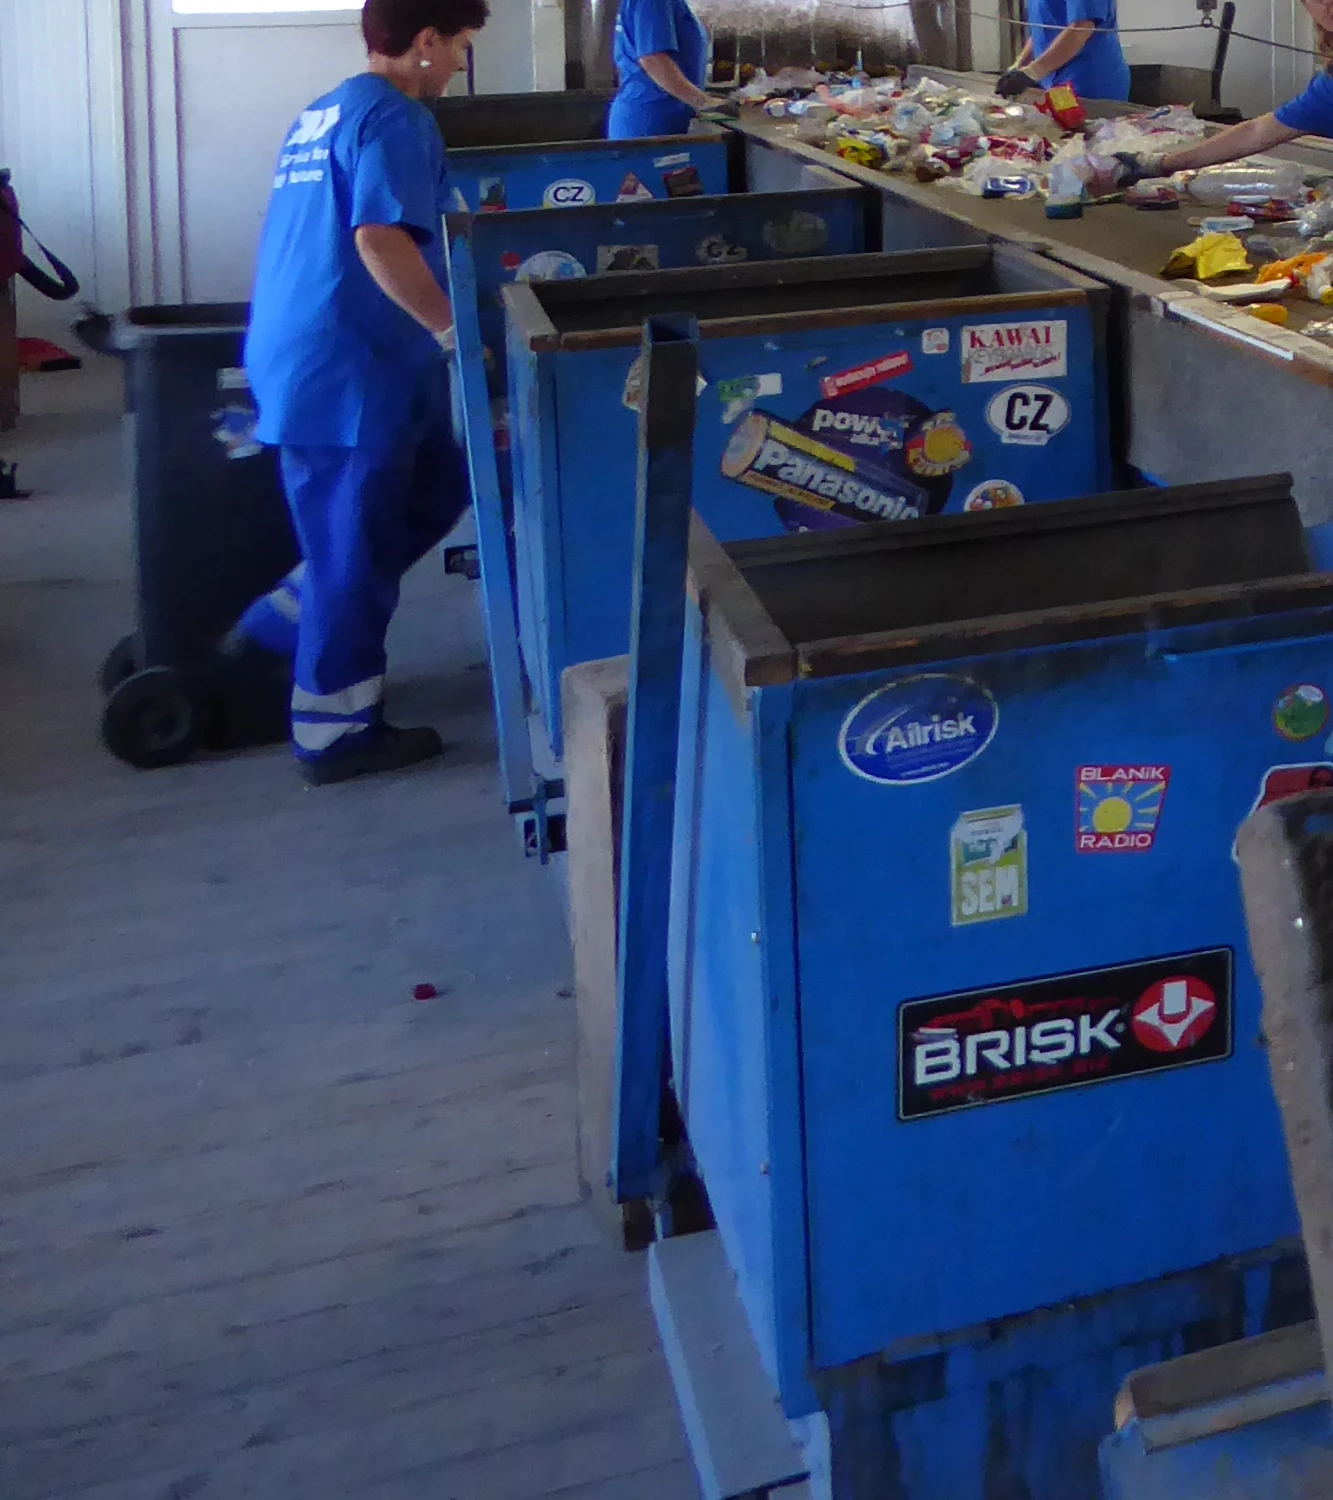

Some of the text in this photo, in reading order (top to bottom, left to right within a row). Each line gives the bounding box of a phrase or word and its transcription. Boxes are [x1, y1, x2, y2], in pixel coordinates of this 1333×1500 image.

[553, 185, 585, 203] CZ
[969, 325, 1051, 349] KAWAI
[1004, 391, 1054, 431] CZ
[1080, 833, 1152, 848] RADIO
[914, 1008, 1121, 1085] BRISK
